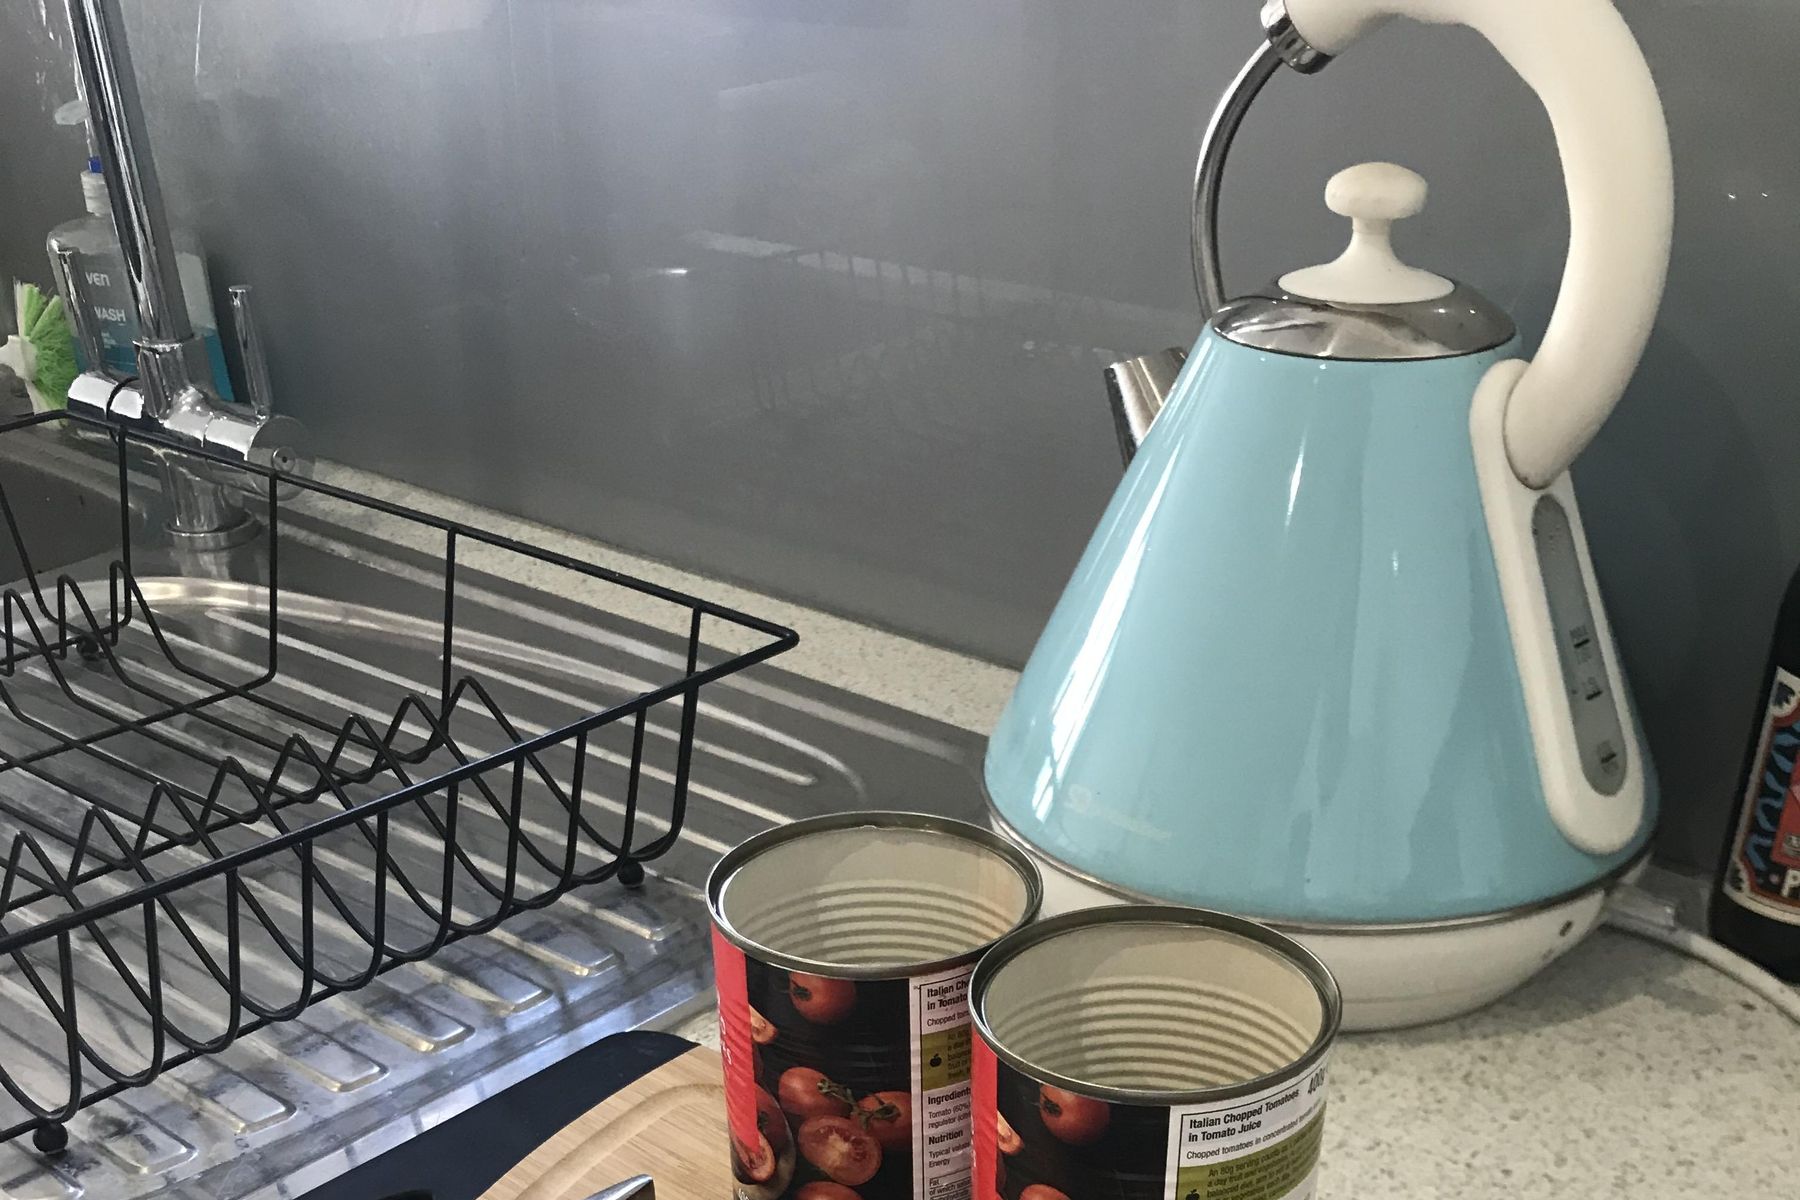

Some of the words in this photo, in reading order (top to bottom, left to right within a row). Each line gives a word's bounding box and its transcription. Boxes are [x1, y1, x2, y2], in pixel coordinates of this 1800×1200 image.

[927, 985, 954, 998] Italian
[927, 1001, 936, 1011] in
[937, 993, 968, 1008] Tomato
[927, 1013, 956, 1027] Chopped
[928, 1109, 952, 1119] Tomato
[1189, 1116, 1221, 1129] Italian
[1223, 1104, 1263, 1123] Chopped
[1265, 1088, 1300, 1113] Tomatoes
[928, 1130, 963, 1146] Nutrition
[1188, 1130, 1198, 1142] in
[1201, 1128, 1236, 1143] Tomato
[1238, 1120, 1262, 1134] Juice
[928, 1147, 951, 1159] Typical
[1187, 1146, 1221, 1160] Chopped
[1221, 1140, 1254, 1154] tomatoes
[928, 1158, 950, 1168] Energy
